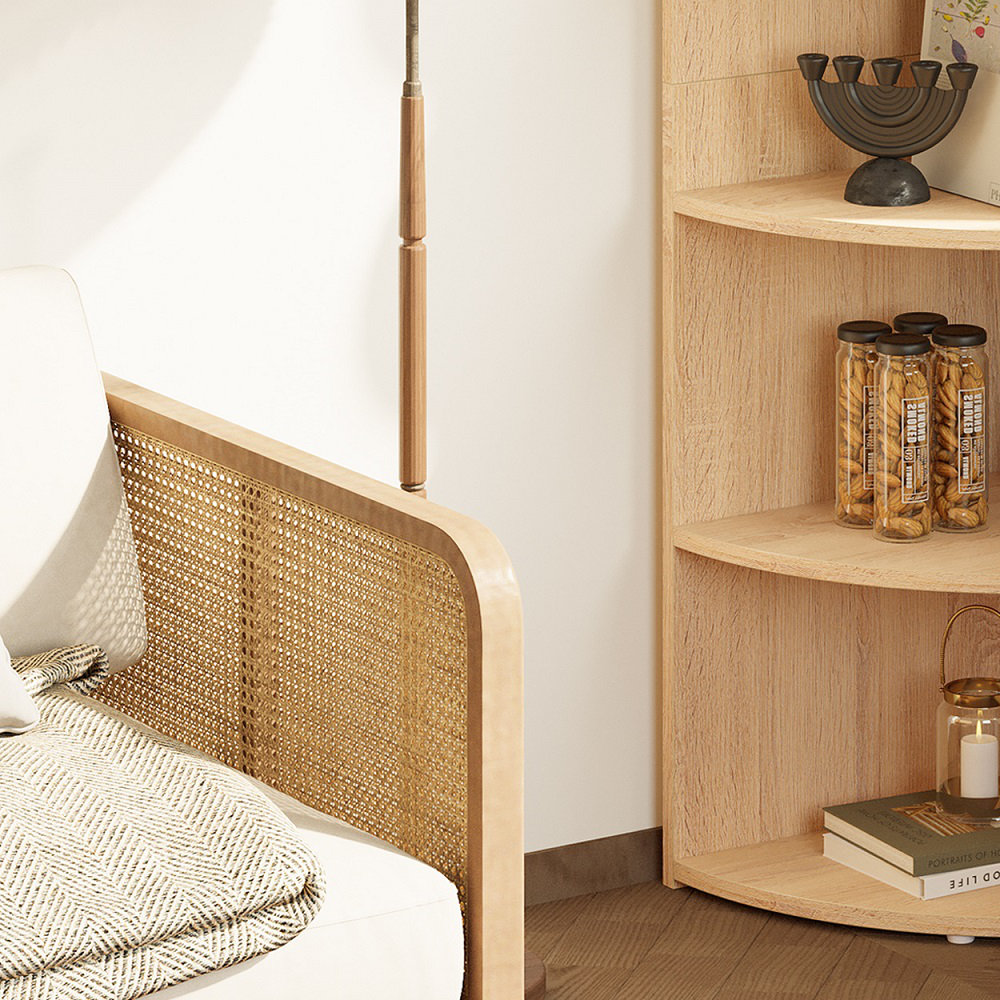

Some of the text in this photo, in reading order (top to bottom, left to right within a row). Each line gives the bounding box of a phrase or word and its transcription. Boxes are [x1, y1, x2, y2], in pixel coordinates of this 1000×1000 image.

[928, 854, 972, 868] PORTRAITS
[976, 851, 986, 860] OF
[950, 876, 977, 890] LIFE
